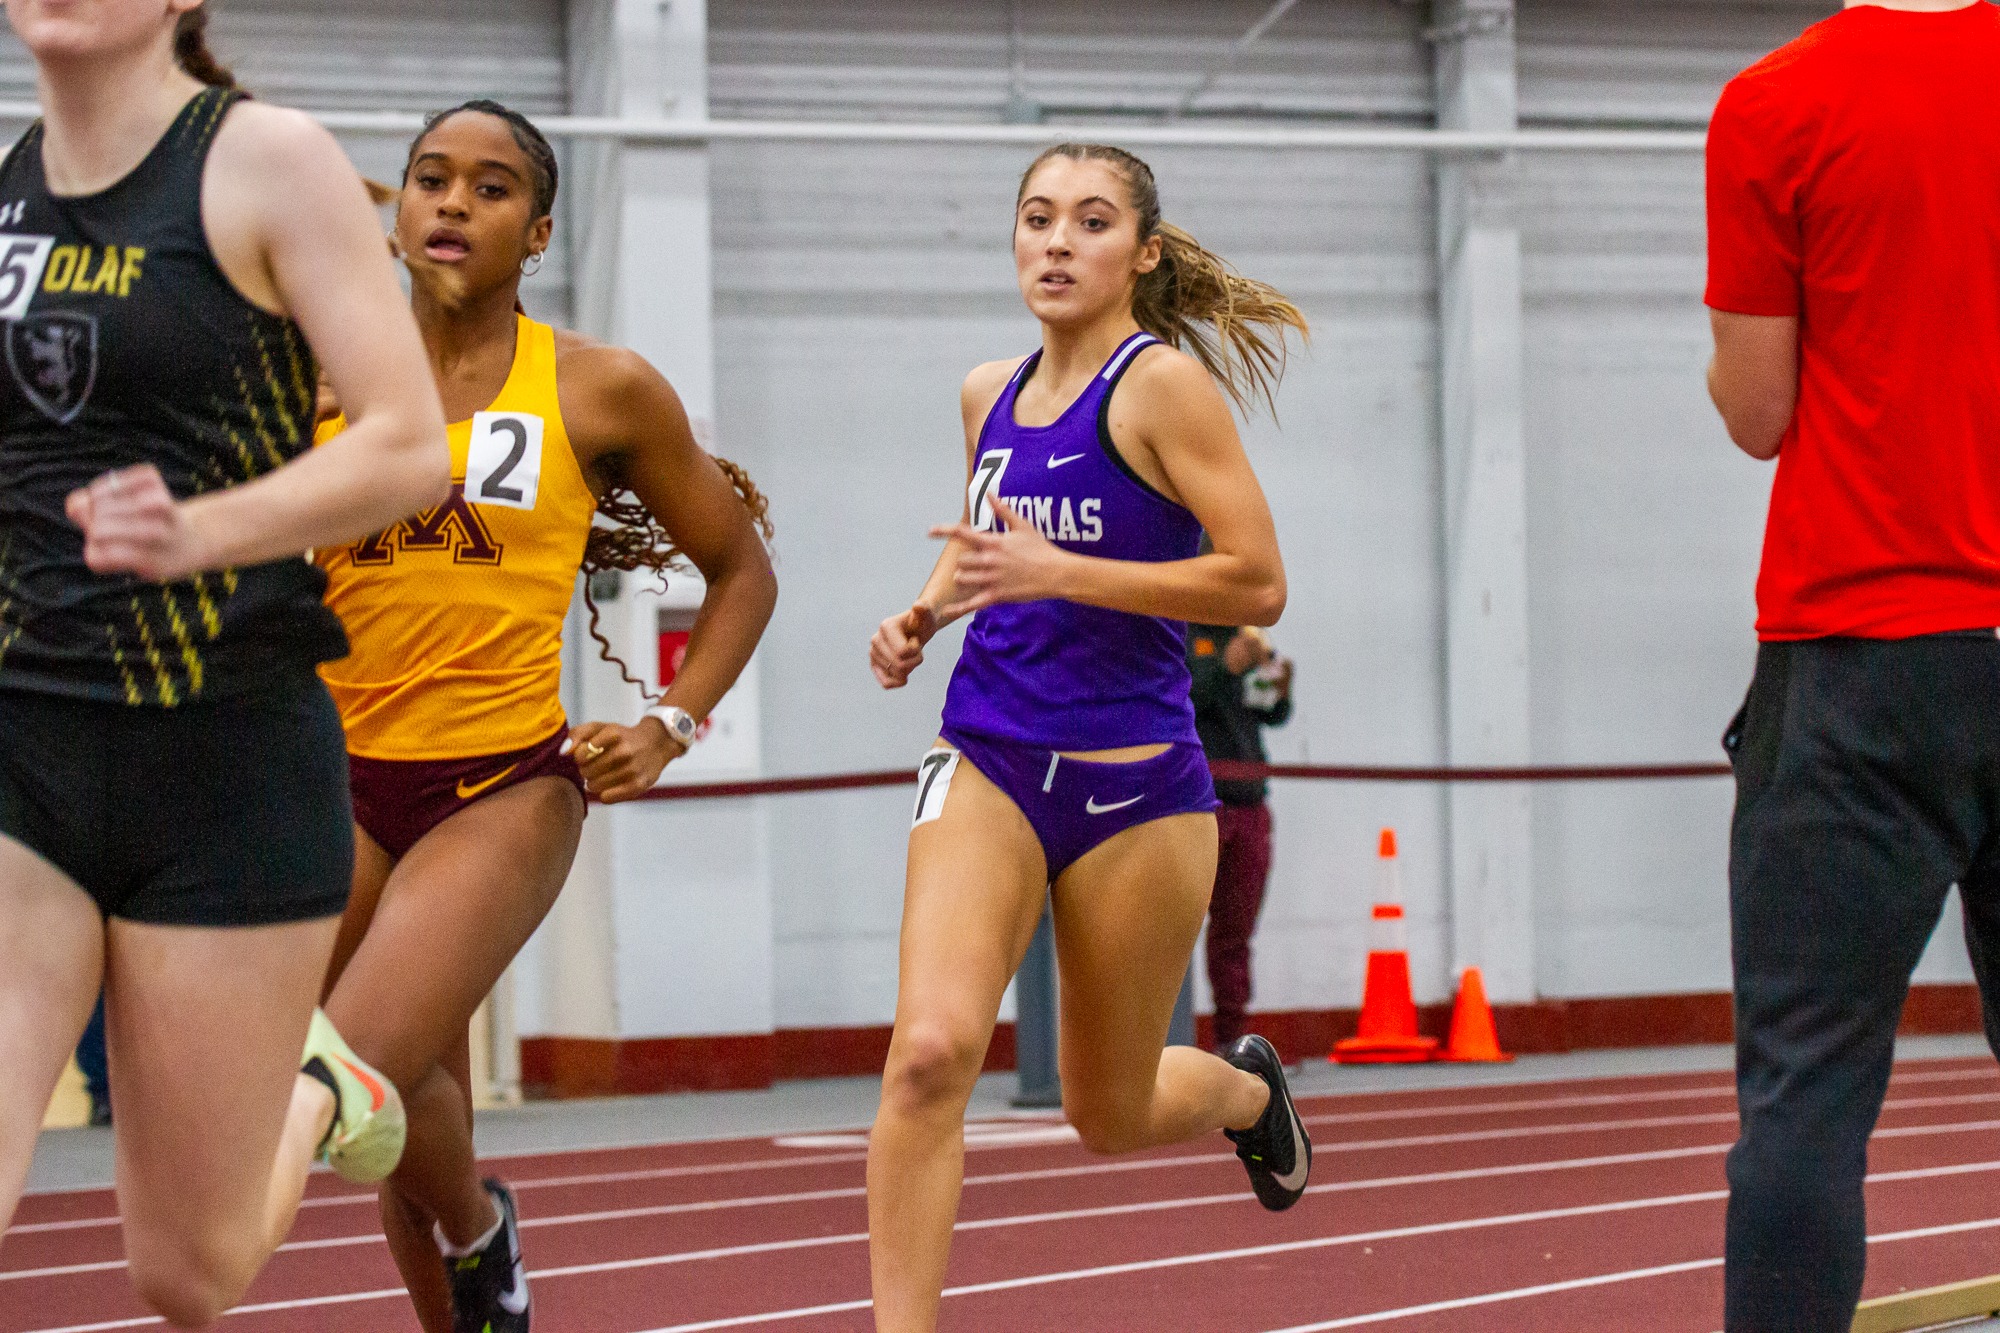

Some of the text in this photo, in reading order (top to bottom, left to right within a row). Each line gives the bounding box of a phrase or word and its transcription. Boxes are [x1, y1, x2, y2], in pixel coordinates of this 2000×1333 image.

[42, 244, 146, 298] OLAF
[480, 417, 528, 503] 2
[973, 456, 1005, 527] 7
[915, 752, 952, 822] 7
